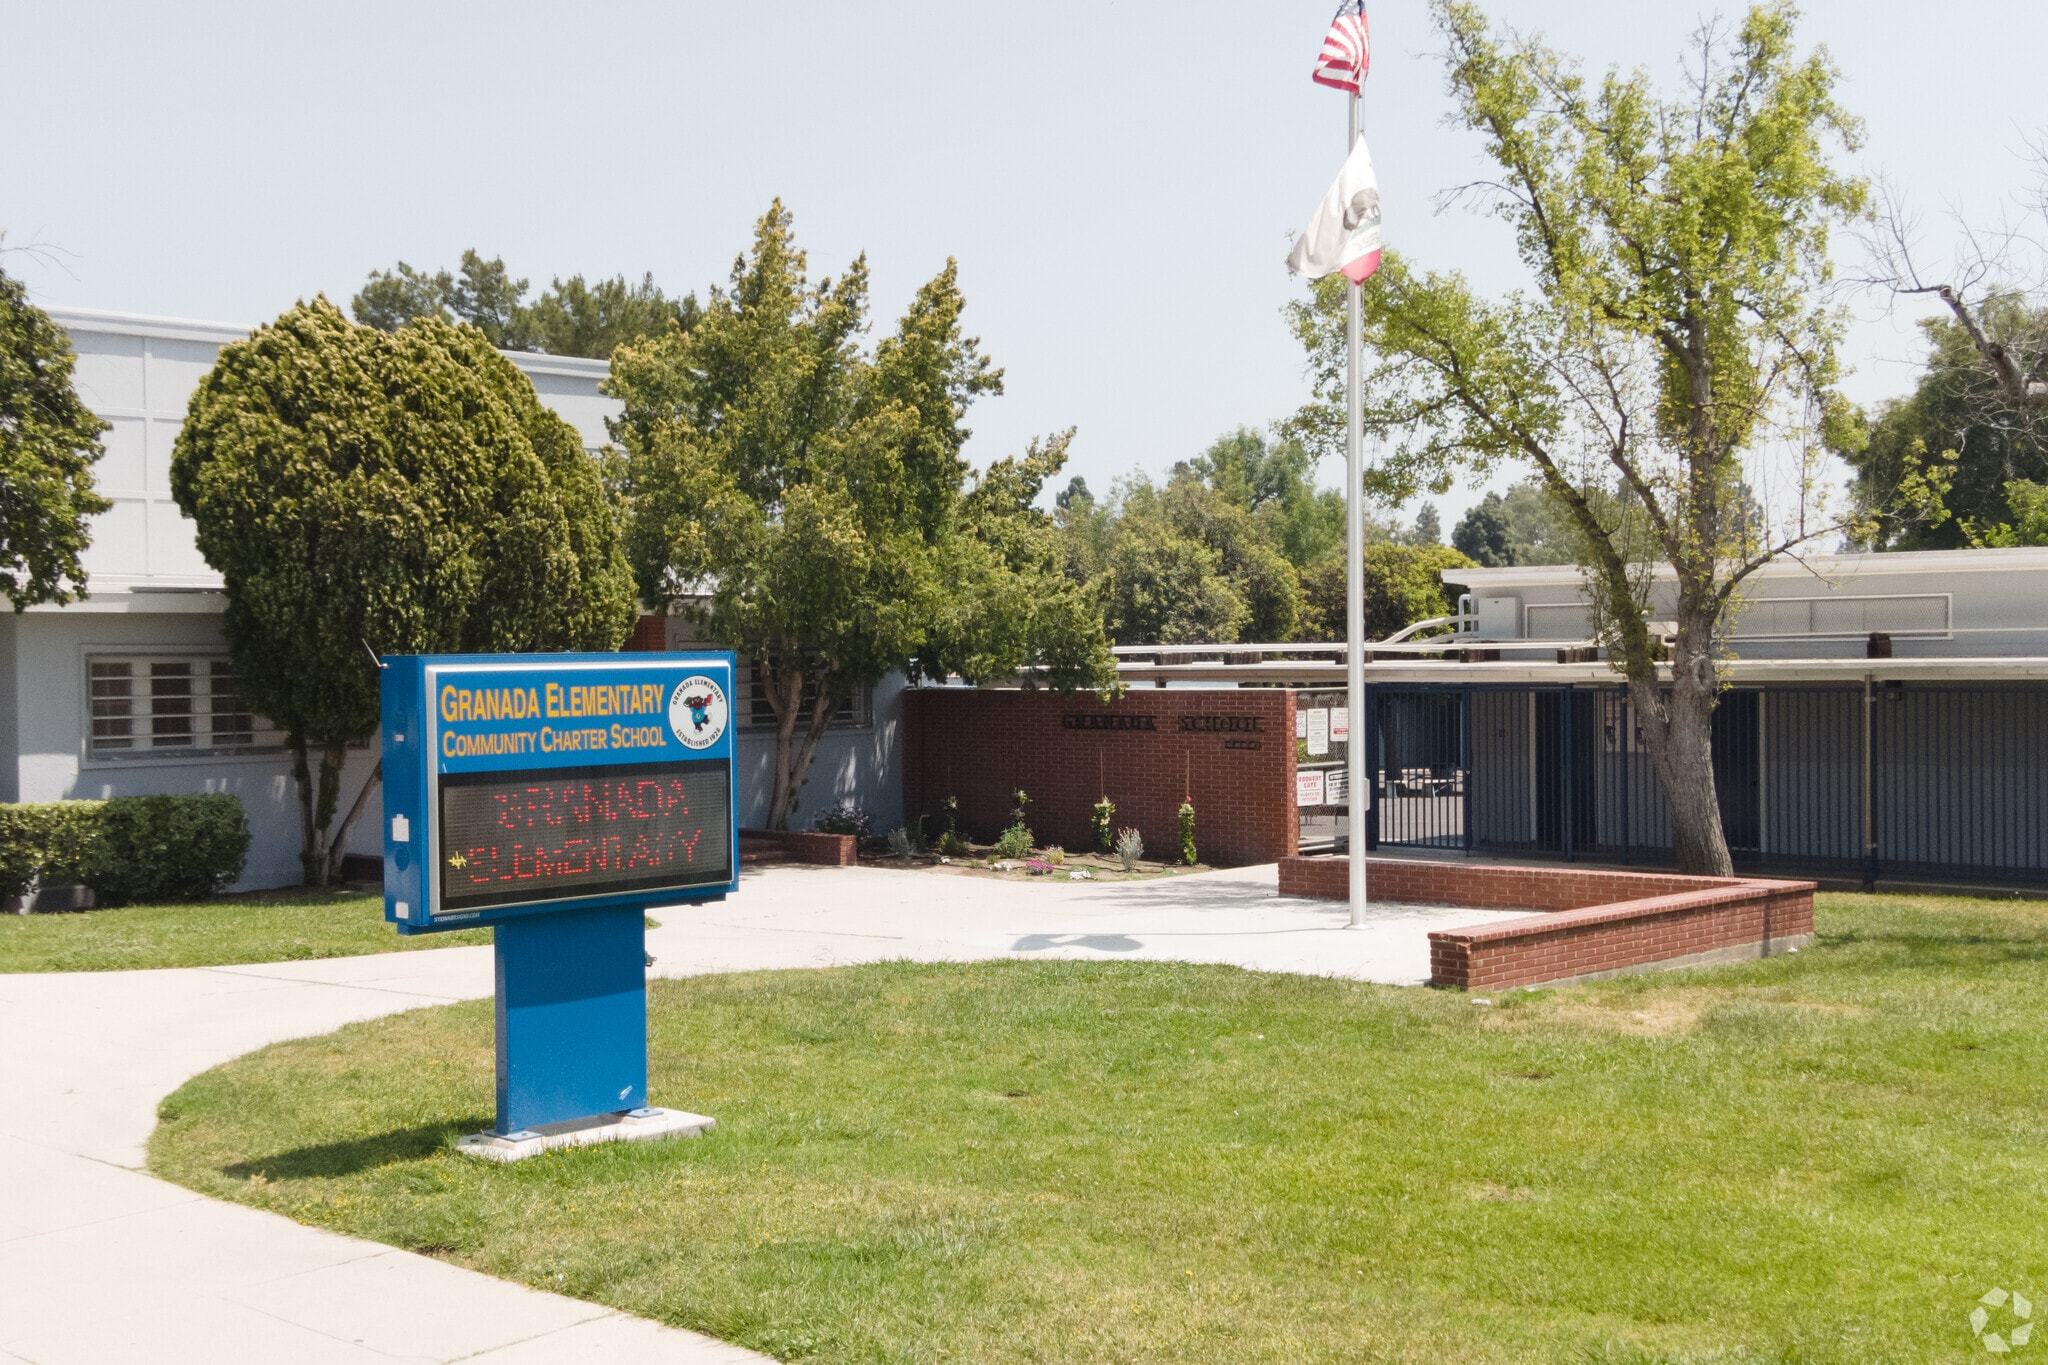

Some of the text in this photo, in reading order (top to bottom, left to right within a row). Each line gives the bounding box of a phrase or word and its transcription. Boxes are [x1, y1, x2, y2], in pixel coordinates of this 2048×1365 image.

[441, 682, 664, 722] GRANADA ELEMENTARY
[443, 723, 667, 758] COMMUNITY CHARTER SCHOOL
